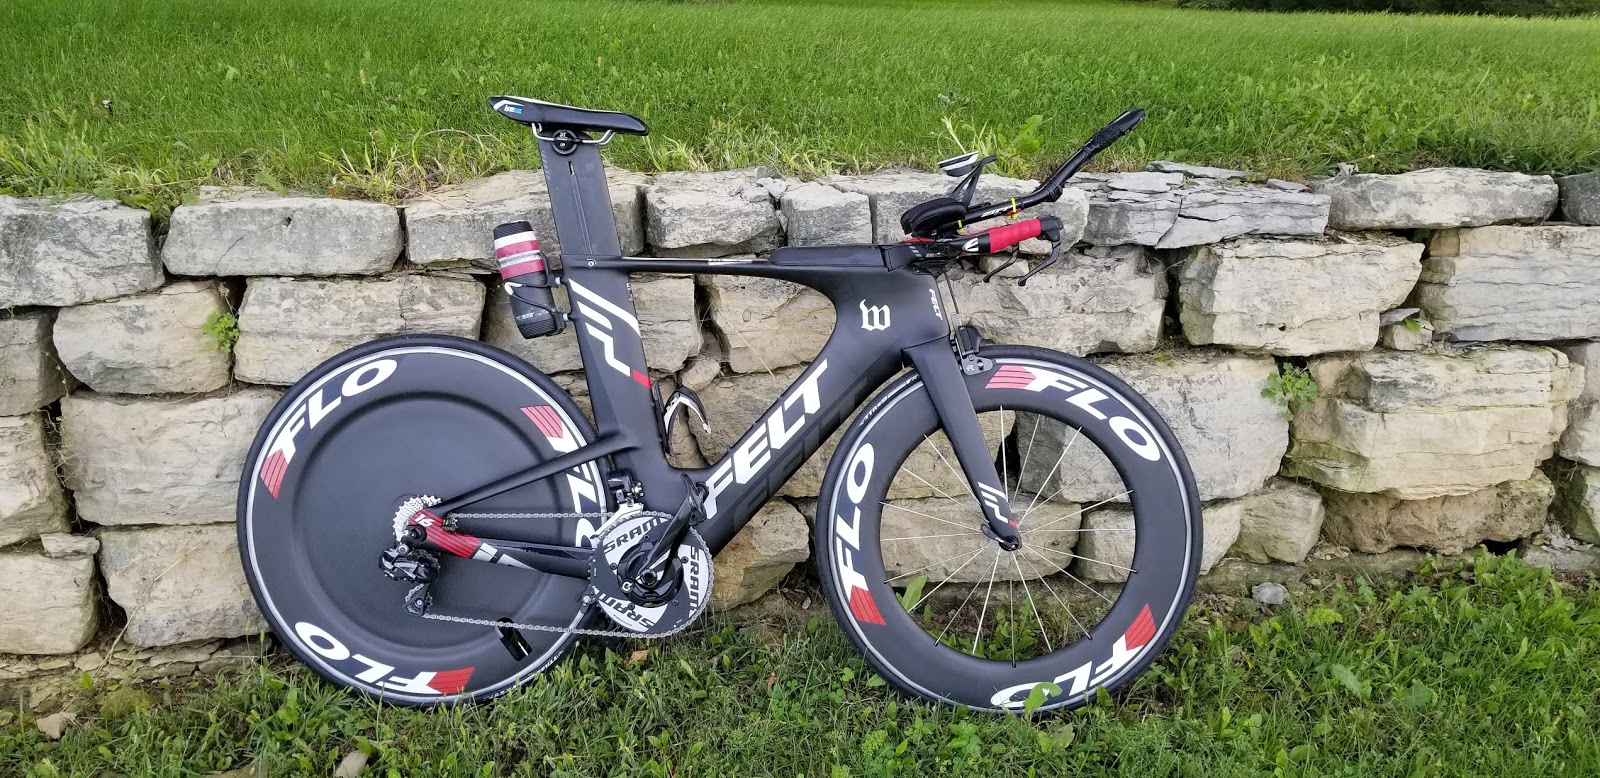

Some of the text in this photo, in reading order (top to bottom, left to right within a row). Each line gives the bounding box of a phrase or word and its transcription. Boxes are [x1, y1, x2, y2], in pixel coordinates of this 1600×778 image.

[929, 288, 943, 320] FELT
[267, 359, 397, 465] FLO
[703, 358, 828, 519] FELT
[1022, 365, 1160, 461] FLO
[603, 517, 664, 555] SRAM
[836, 442, 875, 602] FLO
[598, 593, 656, 628] SRAM
[688, 545, 701, 611] SRAM
[295, 621, 441, 694] FLO
[990, 633, 1144, 708] FLO
